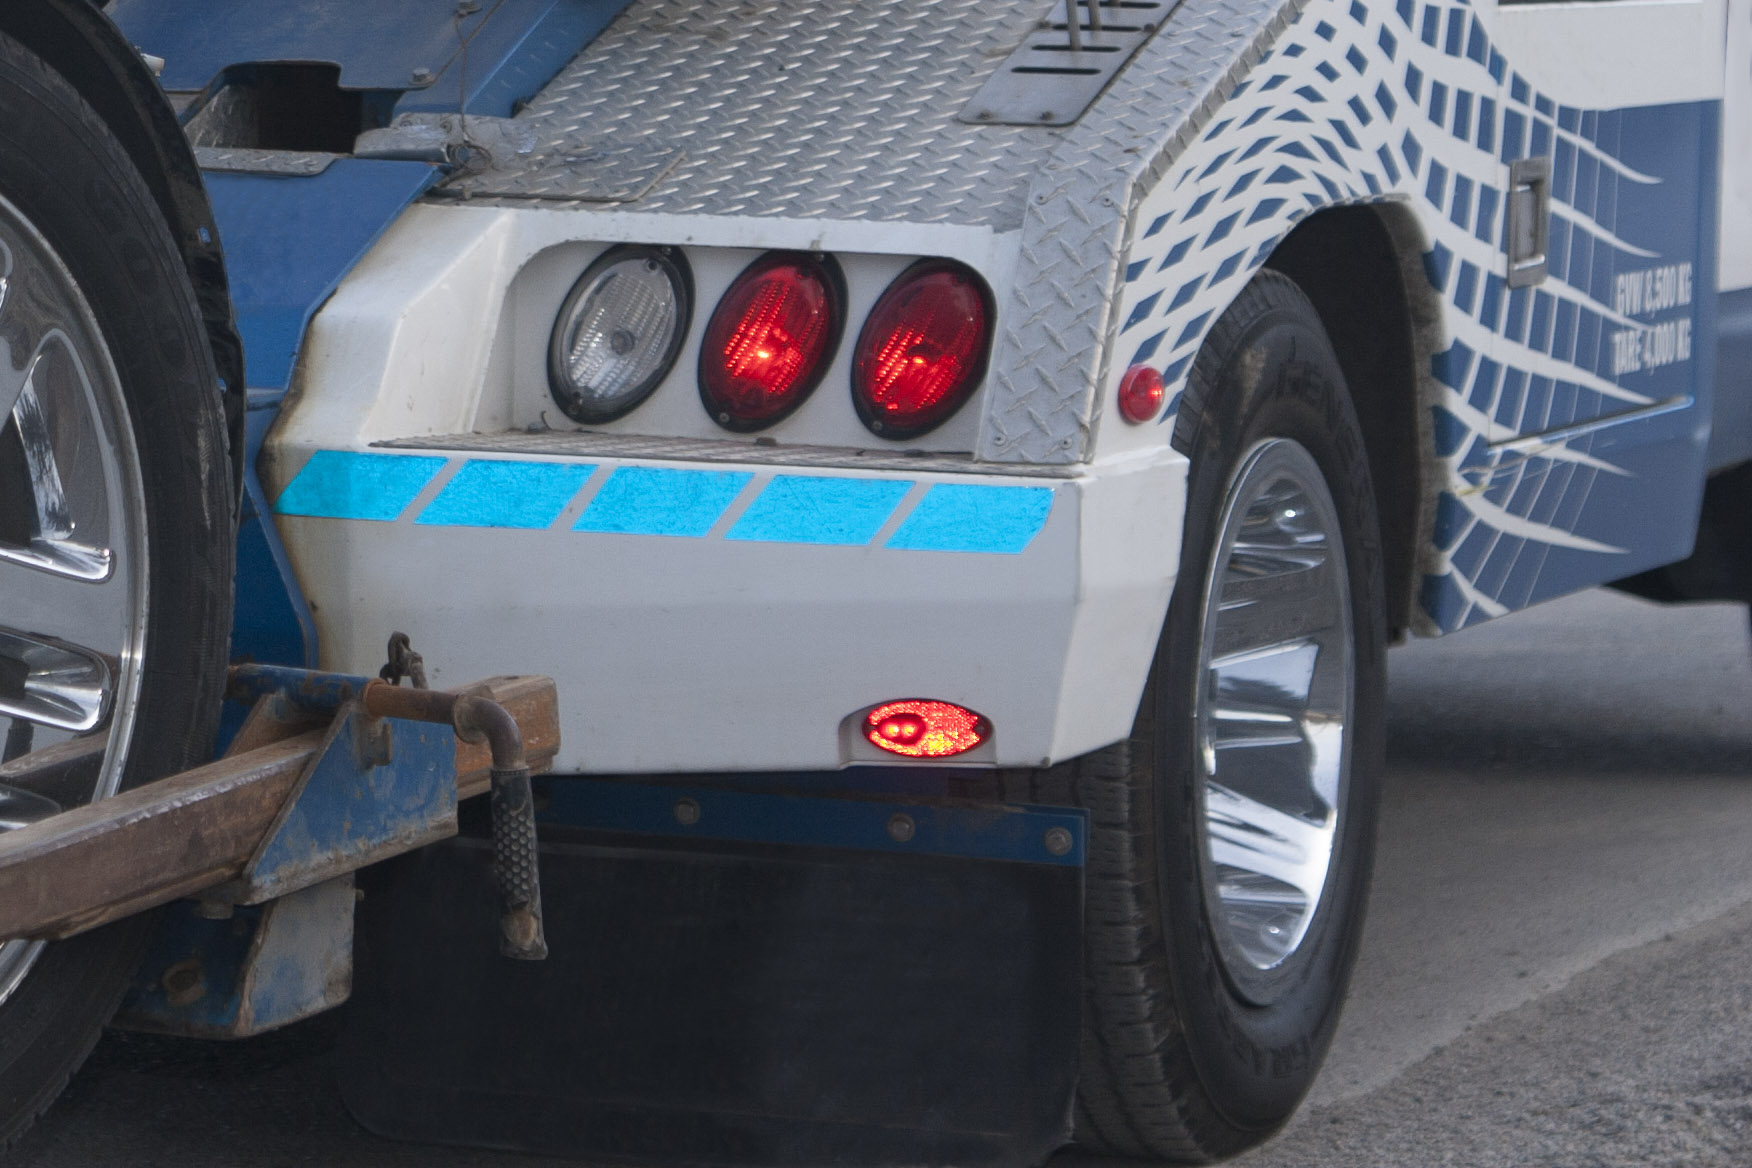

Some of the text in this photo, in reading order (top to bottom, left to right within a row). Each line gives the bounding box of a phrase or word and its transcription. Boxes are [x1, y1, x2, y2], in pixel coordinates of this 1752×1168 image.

[1616, 262, 1692, 319] GVW 8,500 KG
[1612, 318, 1692, 376] TARE 4,000 KG
